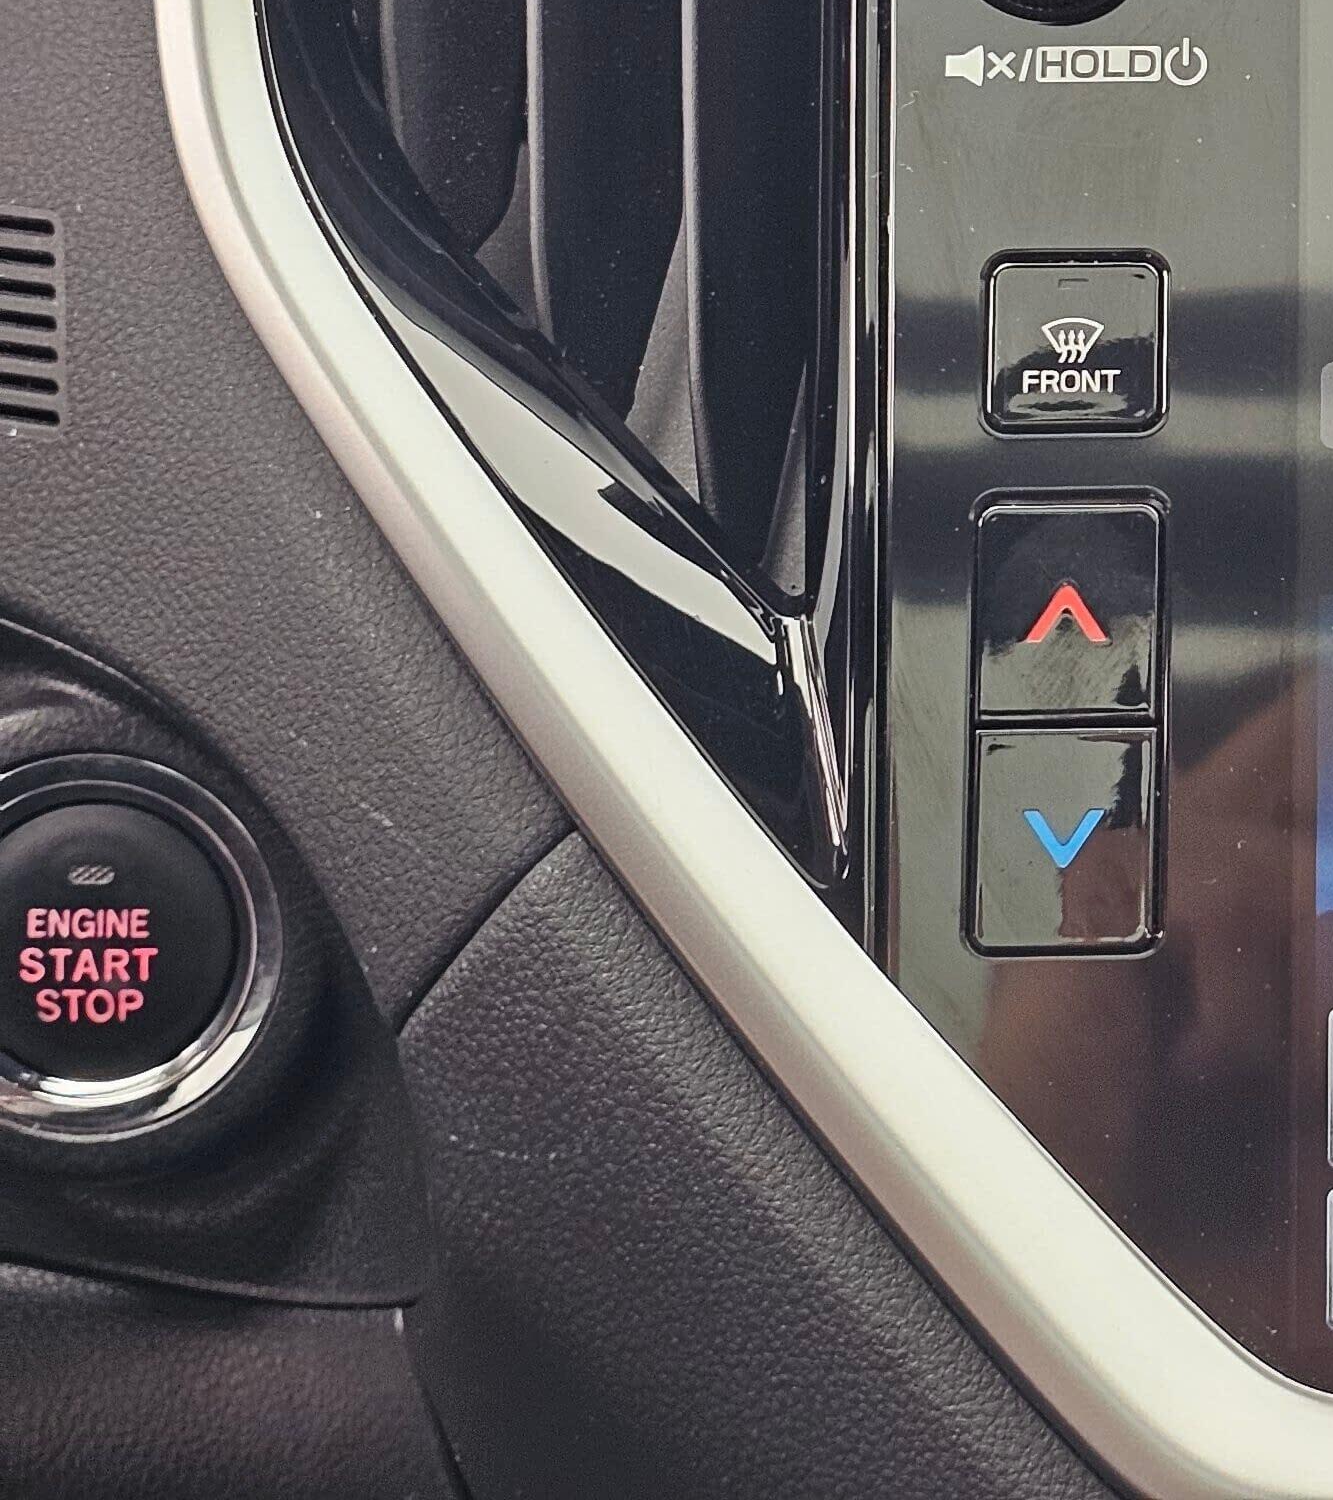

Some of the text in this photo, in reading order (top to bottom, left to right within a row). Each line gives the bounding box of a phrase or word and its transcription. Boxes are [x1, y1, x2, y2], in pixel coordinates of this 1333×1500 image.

[1022, 369, 1121, 394] FRONT
[26, 908, 150, 939] ENGINE
[19, 947, 158, 983] START
[35, 988, 144, 1023] STOP
